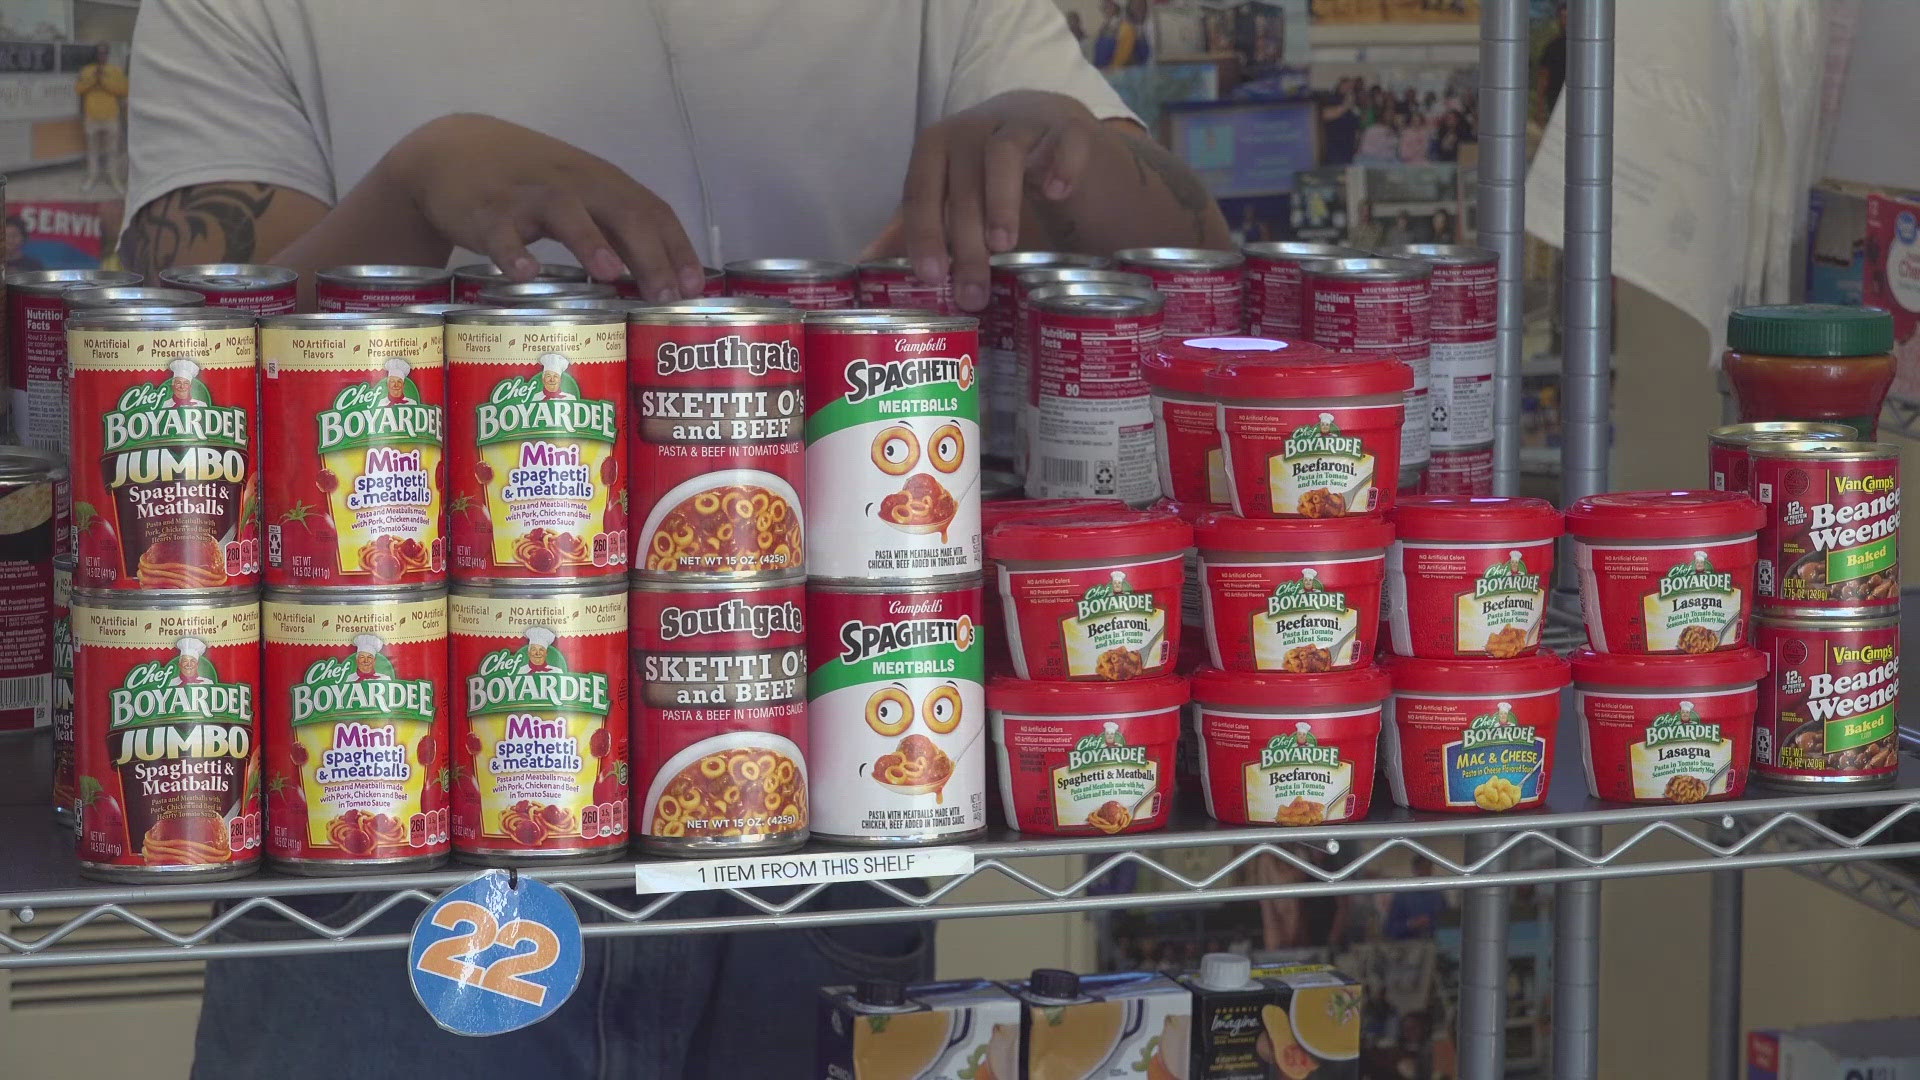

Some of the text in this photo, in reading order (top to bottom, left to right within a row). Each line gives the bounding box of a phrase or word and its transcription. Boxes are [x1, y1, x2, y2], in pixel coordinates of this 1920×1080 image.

[1315, 292, 1349, 303] Nutrition
[1315, 302, 1335, 312] Facts
[27, 320, 50, 330] Facts
[1041, 326, 1077, 340] Nutrition
[657, 335, 800, 375] Southgate
[894, 337, 947, 353] Campbell's
[120, 386, 167, 412] Chef
[336, 387, 382, 411] Chef
[493, 380, 537, 403] Chef
[1065, 383, 1079, 396] 90
[642, 390, 804, 418] SKETTI O's
[878, 397, 957, 414] MEATBALLS
[107, 407, 247, 450] BOYARDEE
[320, 406, 443, 449] BOYARDEE
[479, 402, 616, 441] BOYARDEE
[673, 418, 791, 440] and BEEF
[1292, 427, 1316, 440] Chef
[522, 445, 576, 467] Mini
[658, 443, 799, 457] PASTA & BEEF IN TOMATO SAUCE
[1284, 436, 1362, 459] BOYARDEE
[111, 449, 245, 488] JUMBO
[369, 451, 418, 474] Mini
[1292, 458, 1354, 477] Beefaroni
[358, 473, 426, 495] spaghetti
[512, 468, 587, 488] spaghetti
[129, 482, 229, 504] Spaghetti &
[351, 486, 430, 506] & meatballs
[505, 479, 591, 499] & meatballs
[137, 500, 224, 519] Meatballs
[505, 509, 591, 522] with Pork, Chicken and Beef
[510, 501, 587, 511] Pasta and Meatballs made
[1811, 487, 1900, 530] Beanee
[556, 518, 575, 526] Sauce
[680, 554, 787, 566] NET WT 15 OZ. (425g)
[868, 555, 967, 570] CHICKEN, BEEF ADDED IN TOMATO SAUCE
[875, 546, 963, 559] PASTA WITH MEATBALLS MADE WITH
[1847, 545, 1887, 567] Baked
[1484, 564, 1507, 578] Chef
[1668, 565, 1692, 578] Chef
[1085, 585, 1110, 600] Chef
[1276, 583, 1299, 596] Chef
[1476, 575, 1540, 598] BOYARDEE
[1660, 573, 1731, 597] BOYARDEE
[889, 599, 943, 616] Campbell's
[1077, 593, 1153, 620] BOYARDEE
[1268, 592, 1345, 616] BOYARDEE
[1482, 596, 1533, 615] Beefaroni
[1673, 597, 1722, 613] Lasagna
[273, 612, 316, 624] NO Artificial
[280, 622, 304, 633] Flavors
[337, 613, 393, 623] NO Artificial
[661, 600, 804, 640] Southgate
[1087, 617, 1148, 638] Beefaroni
[1276, 615, 1339, 634] Beefaroni
[307, 660, 350, 685] Chef
[480, 652, 522, 676] Chef
[645, 650, 807, 682] SKETTI O's
[872, 658, 955, 675] MEATBALLS
[127, 664, 174, 689] Chef
[1808, 655, 1899, 700] Beanee
[292, 681, 434, 722] BOYARDEE
[468, 674, 608, 714] BOYARDEE
[677, 679, 796, 704] and BEEF
[1807, 678, 1899, 722] Weenee
[112, 684, 252, 727] BOYARDEE
[508, 717, 563, 740] Mini
[1472, 717, 1496, 729] Chef
[1654, 714, 1679, 727] Chef
[1844, 715, 1884, 737] Baked
[117, 725, 250, 765] JUMBO
[336, 725, 392, 748] Mini
[1077, 737, 1102, 751] Chef
[1269, 737, 1293, 749] Chef
[1463, 726, 1535, 748] BOYARDEE
[1646, 724, 1720, 747] BOYARDEE
[326, 749, 403, 770] spaghetti
[499, 740, 574, 761] spaghetti
[1069, 746, 1146, 770] BOYARDEE
[1261, 748, 1339, 768] BOYARDEE
[1457, 749, 1537, 769] MAC & CHEESE
[1658, 747, 1710, 761] Lasagna
[135, 759, 234, 781] Spaghetti &
[319, 762, 408, 781] & meatballs
[492, 753, 579, 770] & meatballs
[142, 774, 229, 797] Meatballs
[1058, 769, 1154, 789] Spaghetti & Meatballs
[1269, 768, 1331, 785] Beefaroni
[698, 854, 915, 883] 1 ITEM FROM THIS SHELF
[416, 899, 561, 1007] 22
